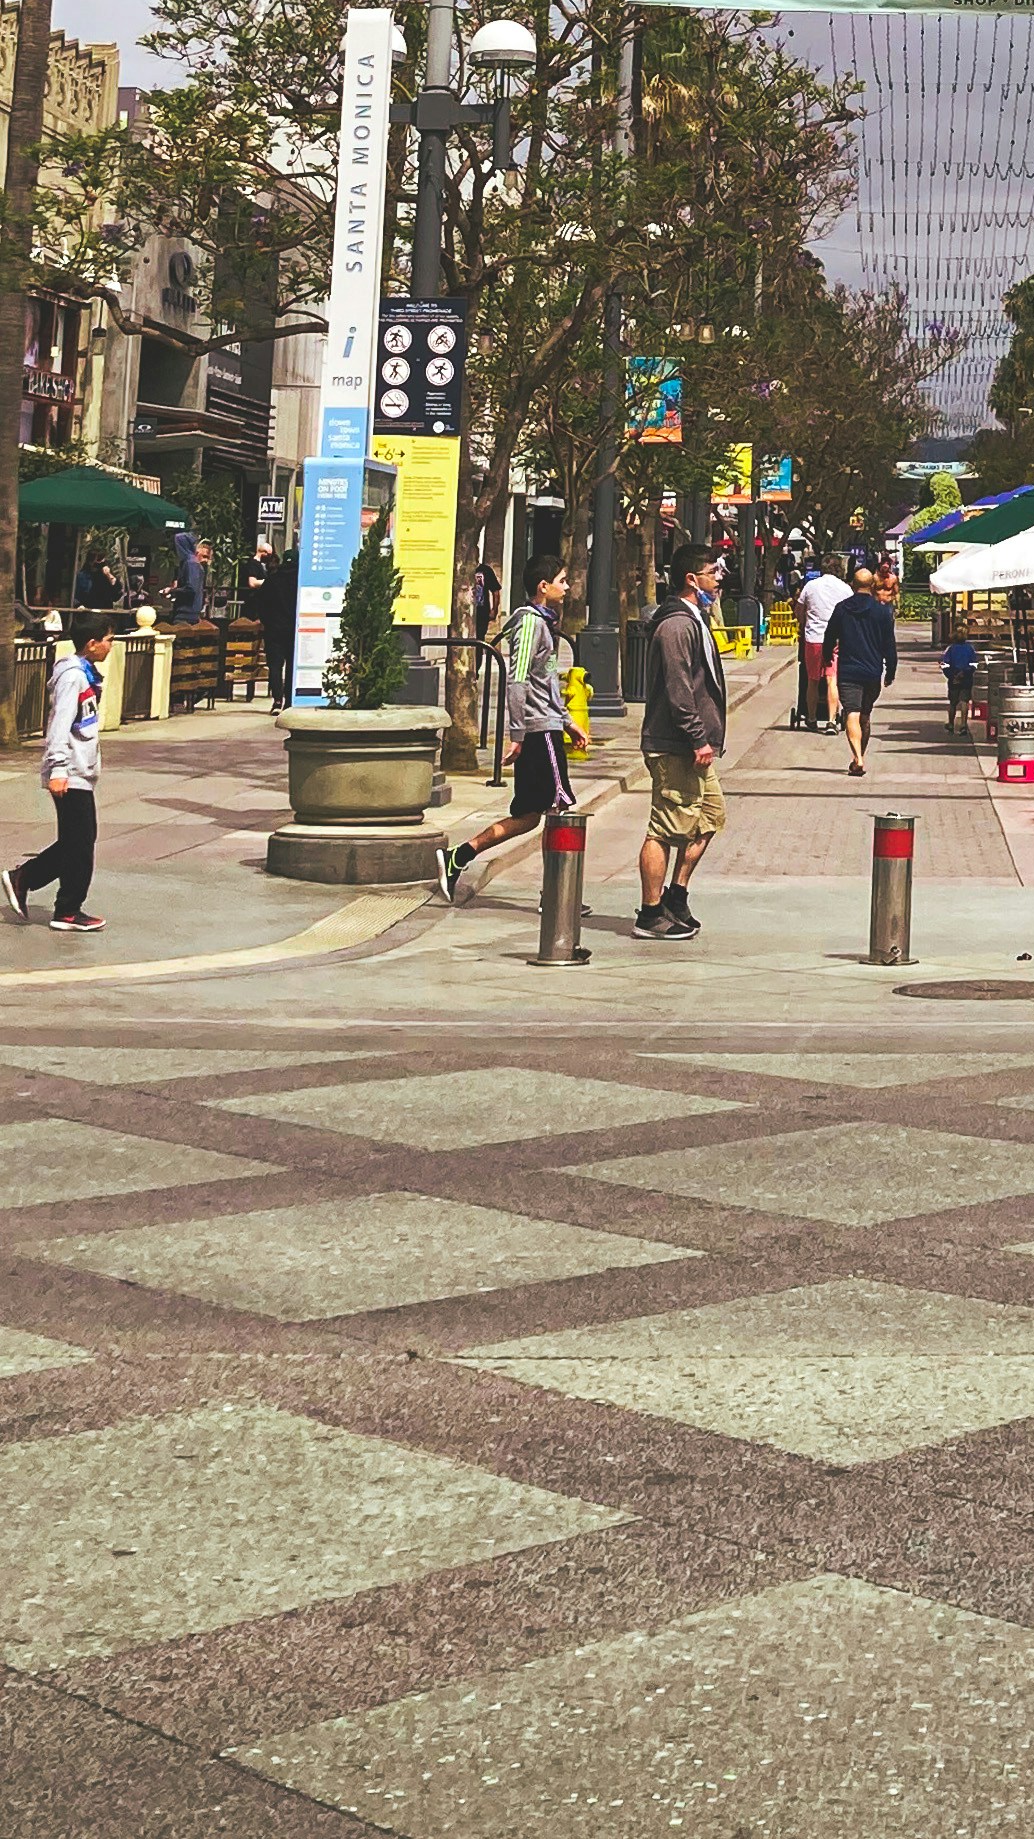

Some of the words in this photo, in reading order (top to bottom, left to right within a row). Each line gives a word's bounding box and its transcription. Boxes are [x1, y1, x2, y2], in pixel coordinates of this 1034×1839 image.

[352, 54, 375, 165] MONICA
[346, 182, 368, 273] SANTA
[332, 375, 363, 391] map
[262, 501, 283, 512] ATM
